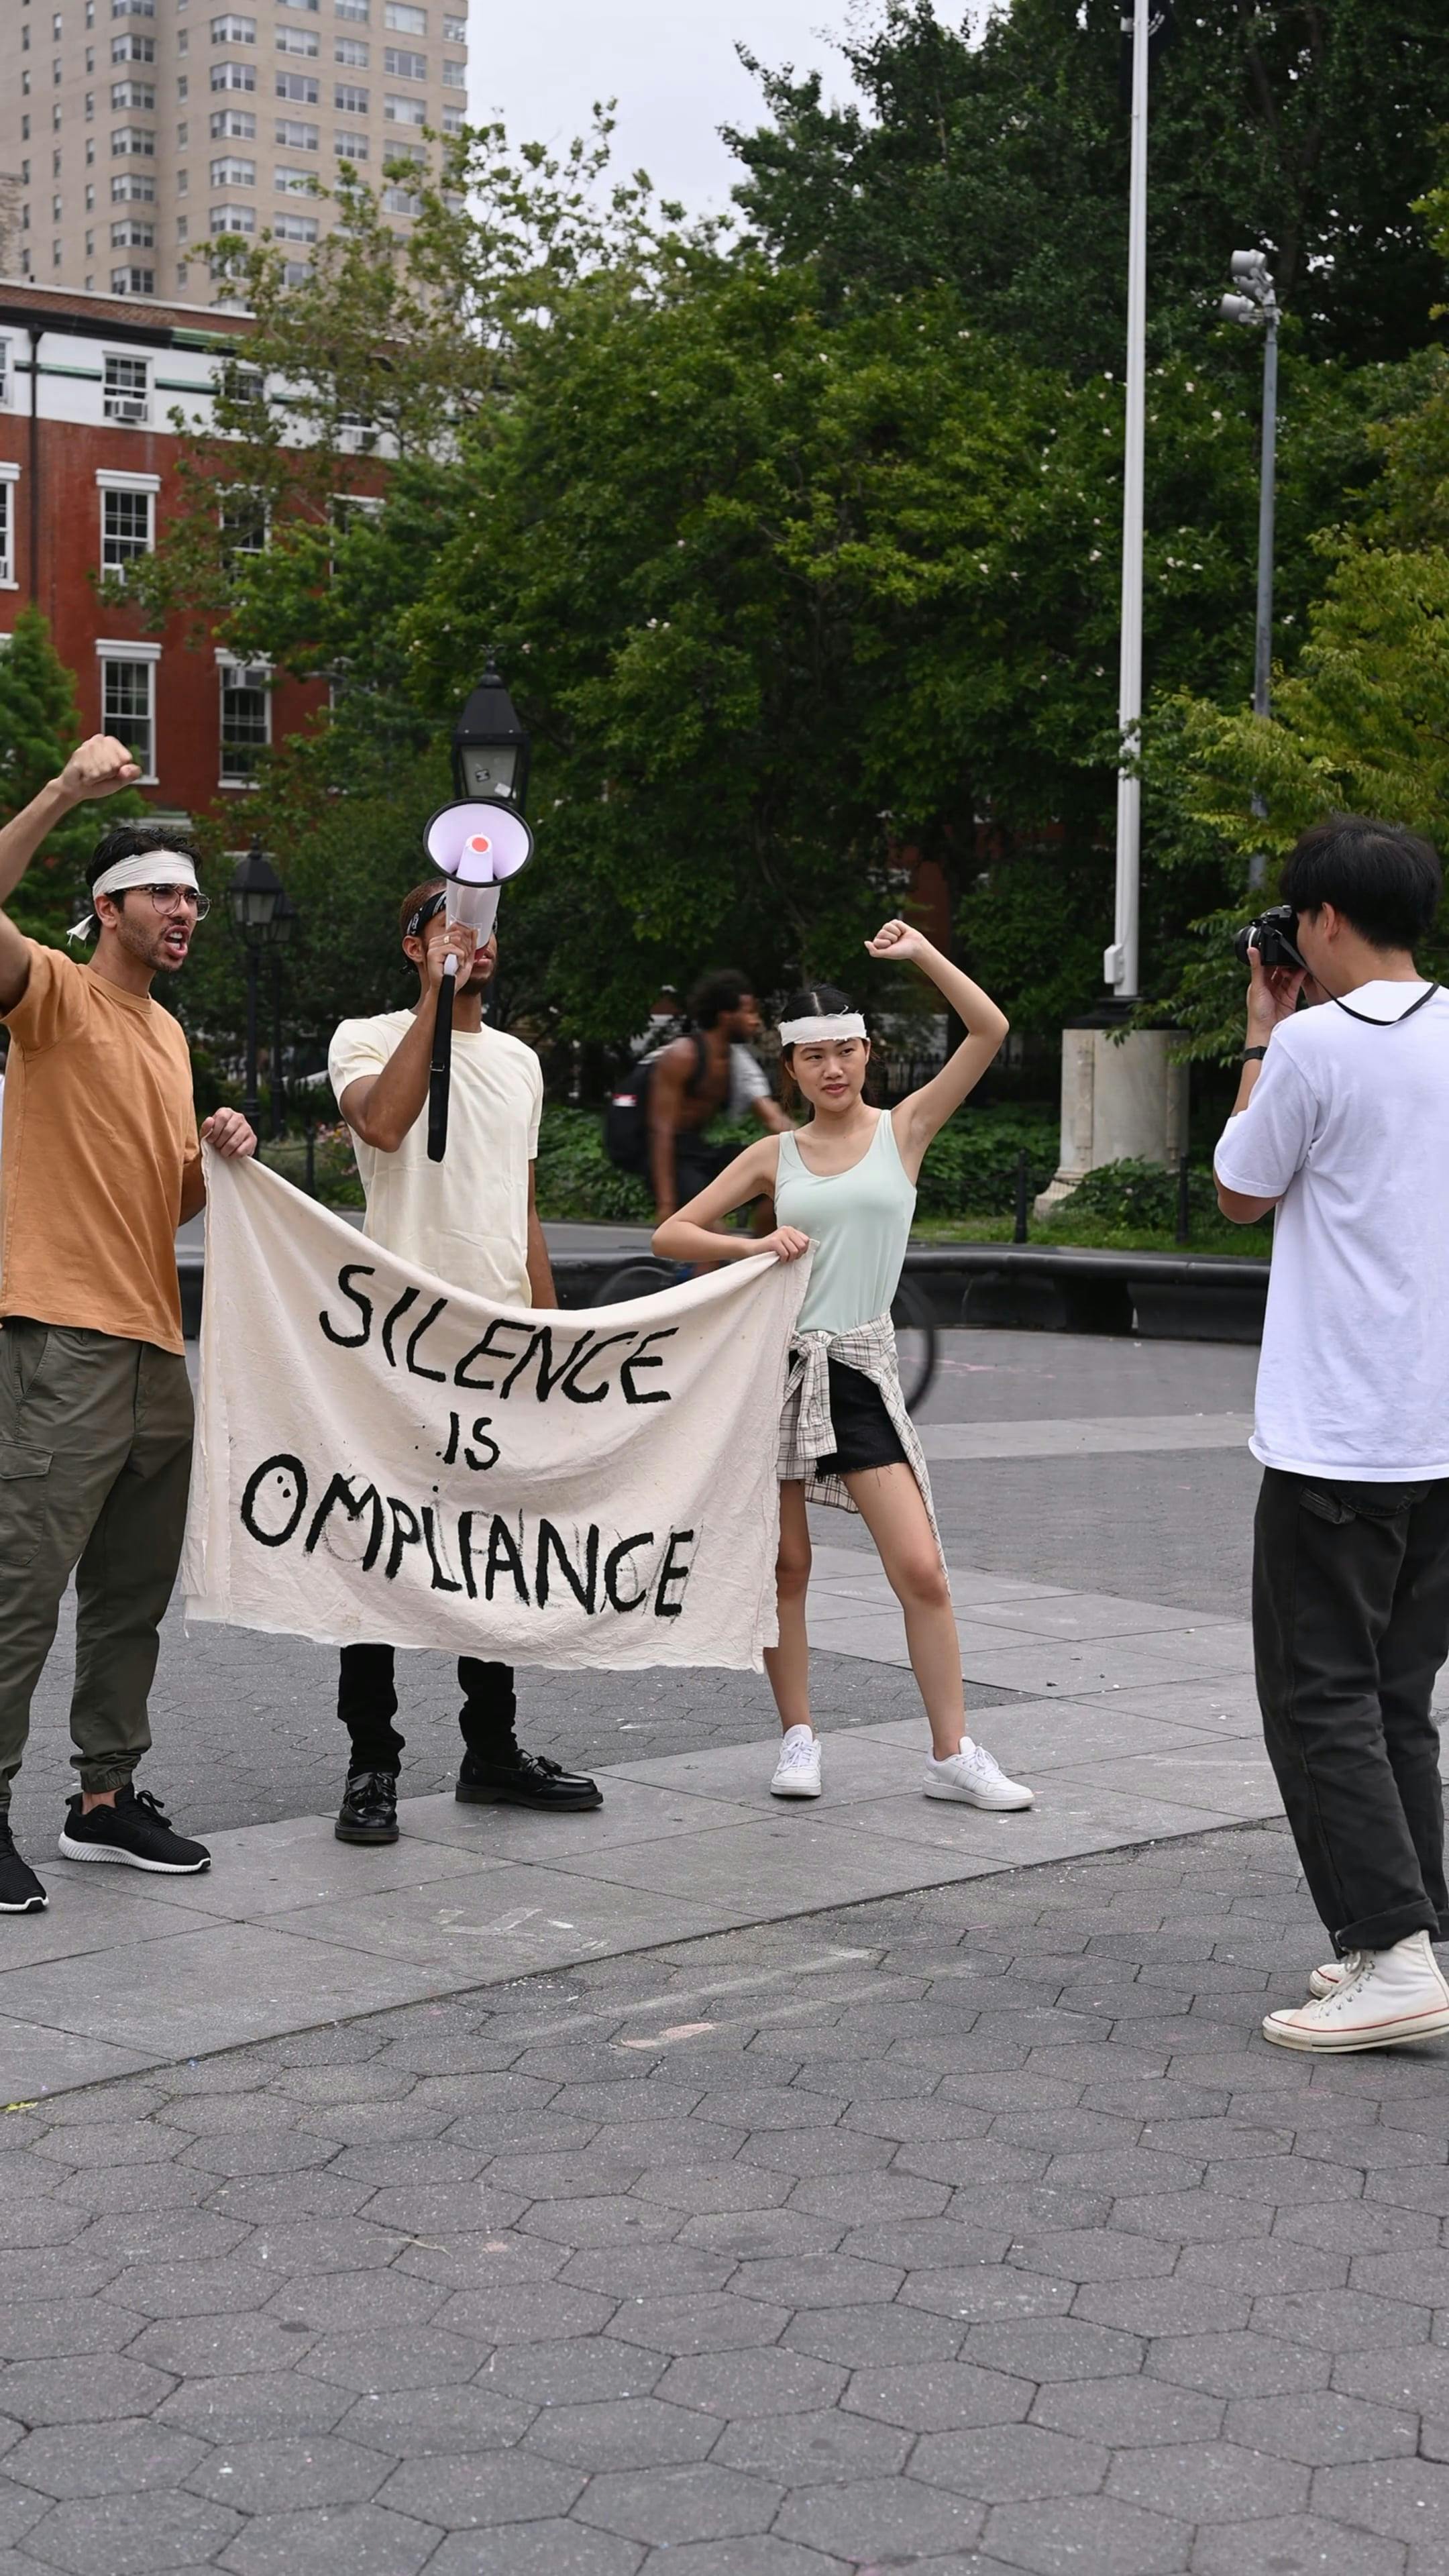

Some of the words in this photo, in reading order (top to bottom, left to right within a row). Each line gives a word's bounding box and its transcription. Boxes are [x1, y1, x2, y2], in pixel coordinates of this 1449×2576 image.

[319, 1264, 680, 1405] SILENCE
[441, 1411, 501, 1472] IS
[240, 1453, 695, 1618] OMPLIANCE
